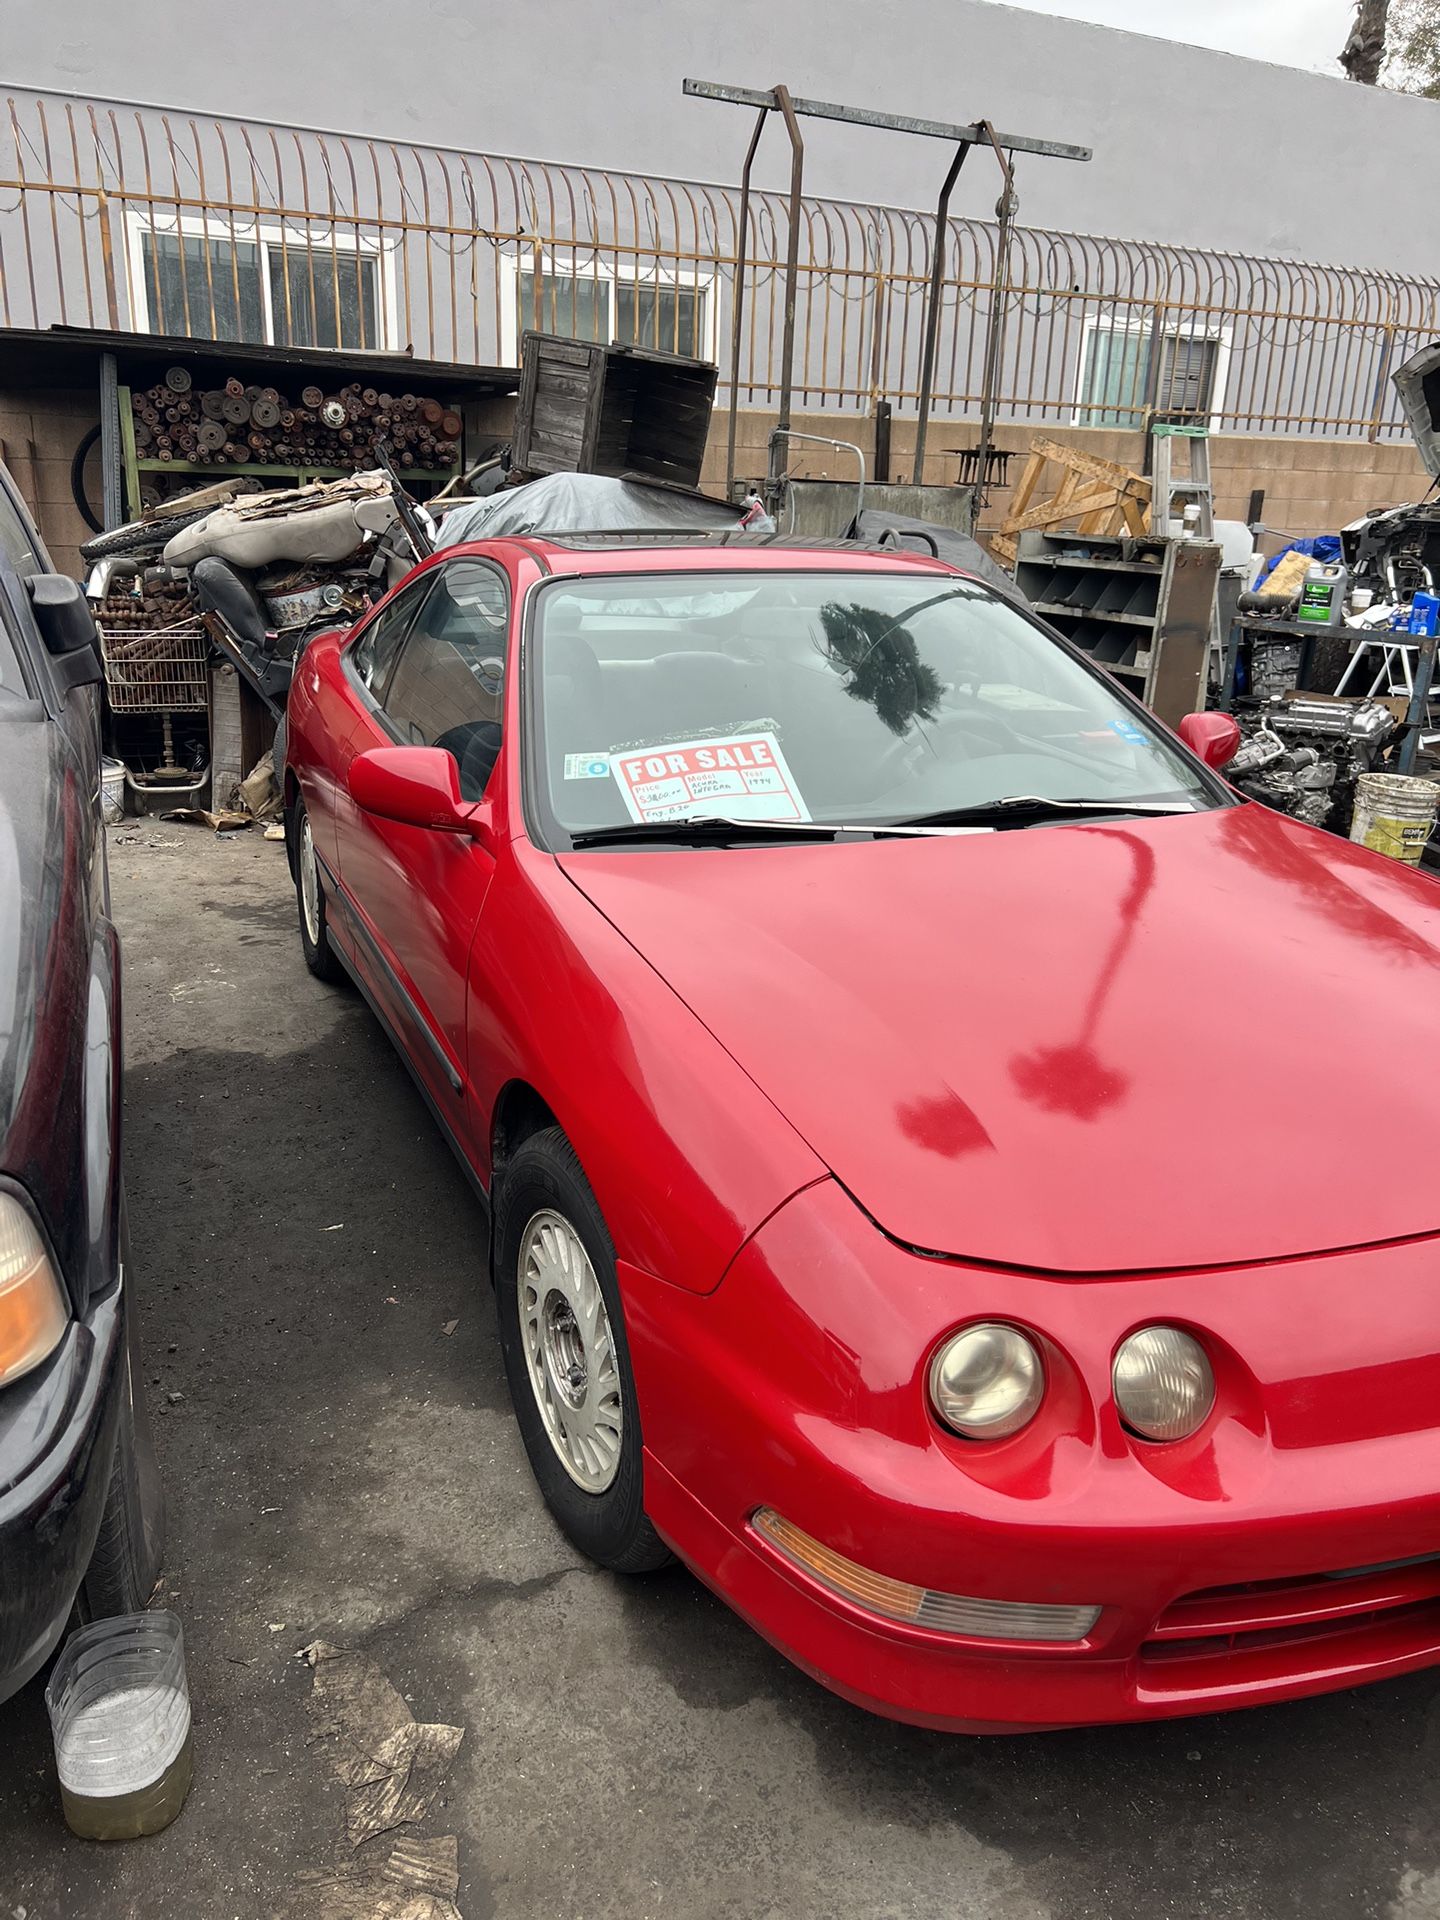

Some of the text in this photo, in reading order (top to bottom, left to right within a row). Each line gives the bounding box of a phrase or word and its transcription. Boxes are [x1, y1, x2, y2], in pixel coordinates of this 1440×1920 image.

[626, 755, 690, 783] FOR
[695, 743, 772, 768] SALE
[687, 773, 716, 783] Model
[743, 770, 763, 778] Year
[635, 784, 660, 793] Price
